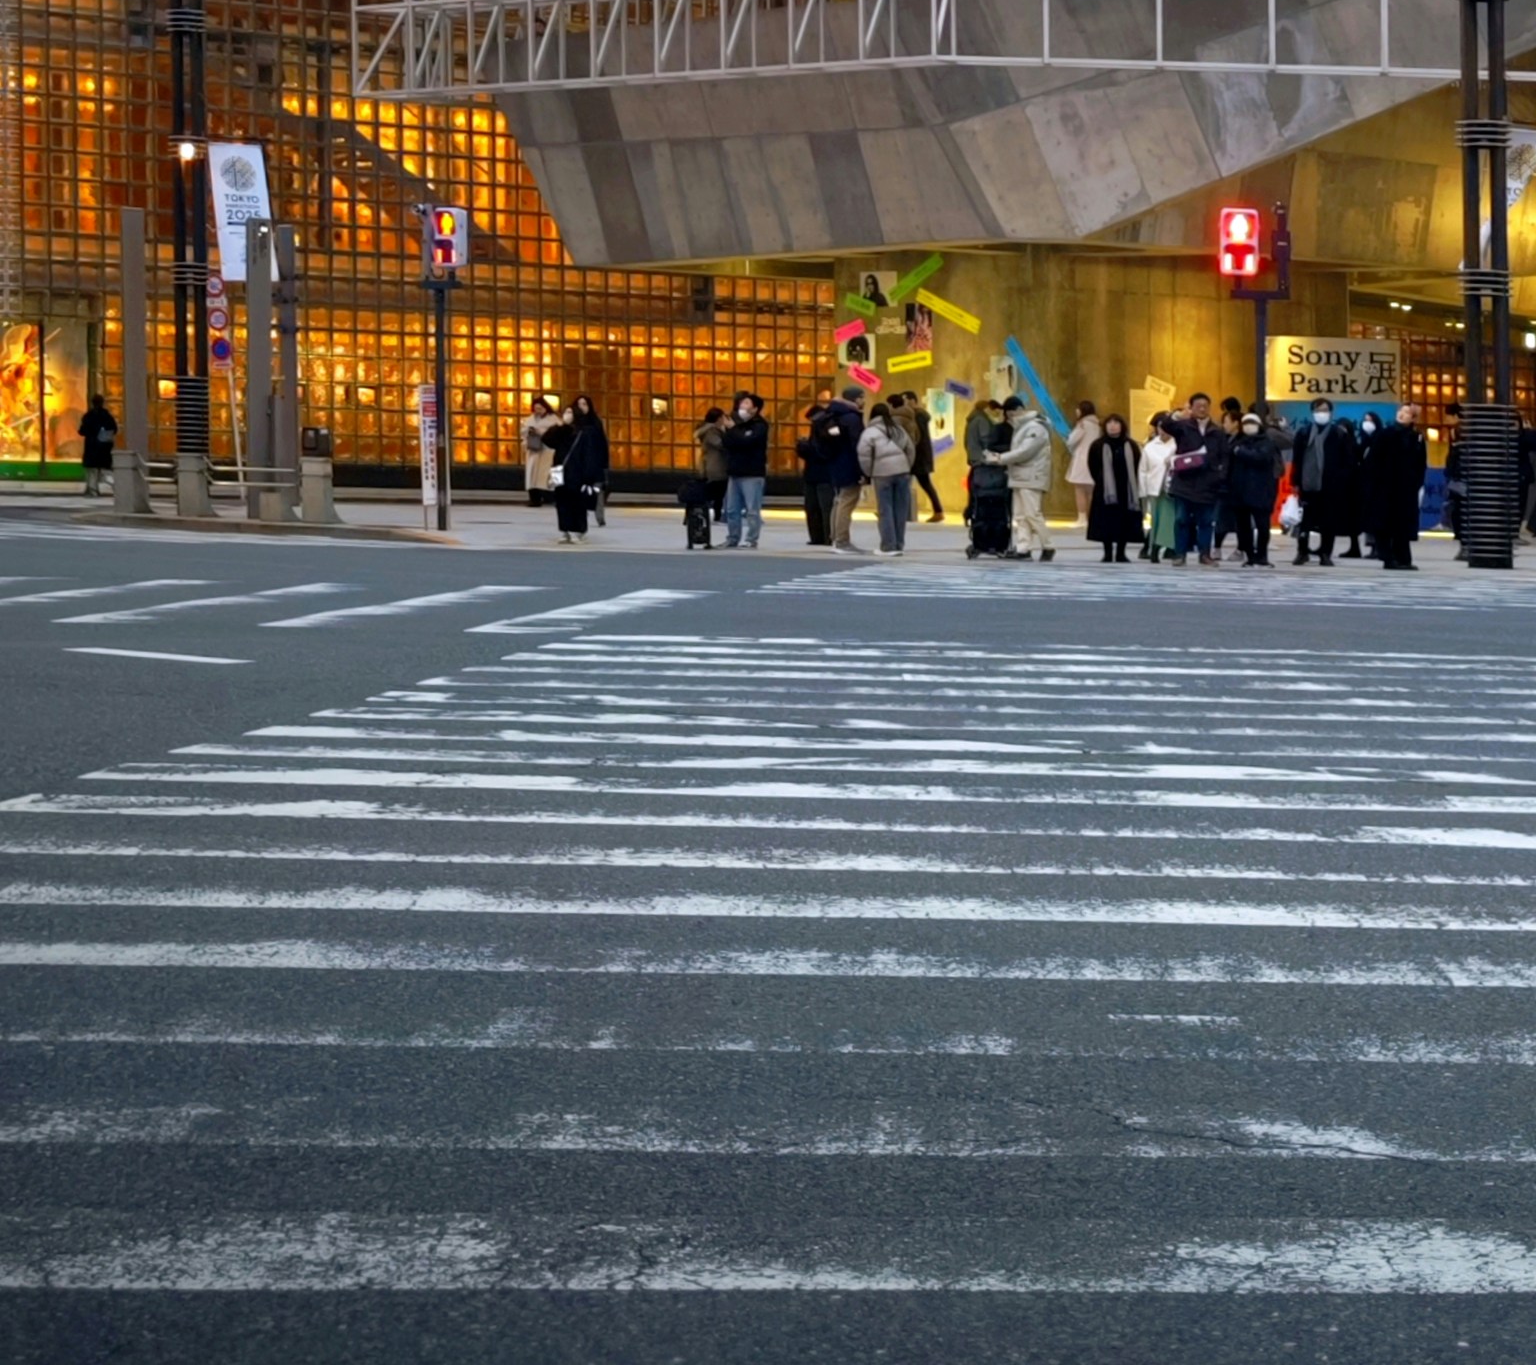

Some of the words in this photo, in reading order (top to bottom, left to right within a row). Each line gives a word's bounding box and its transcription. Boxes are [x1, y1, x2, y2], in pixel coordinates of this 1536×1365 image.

[224, 193, 260, 204] TOKYO
[1287, 344, 1362, 372] Sony
[1288, 372, 1359, 394] Park
